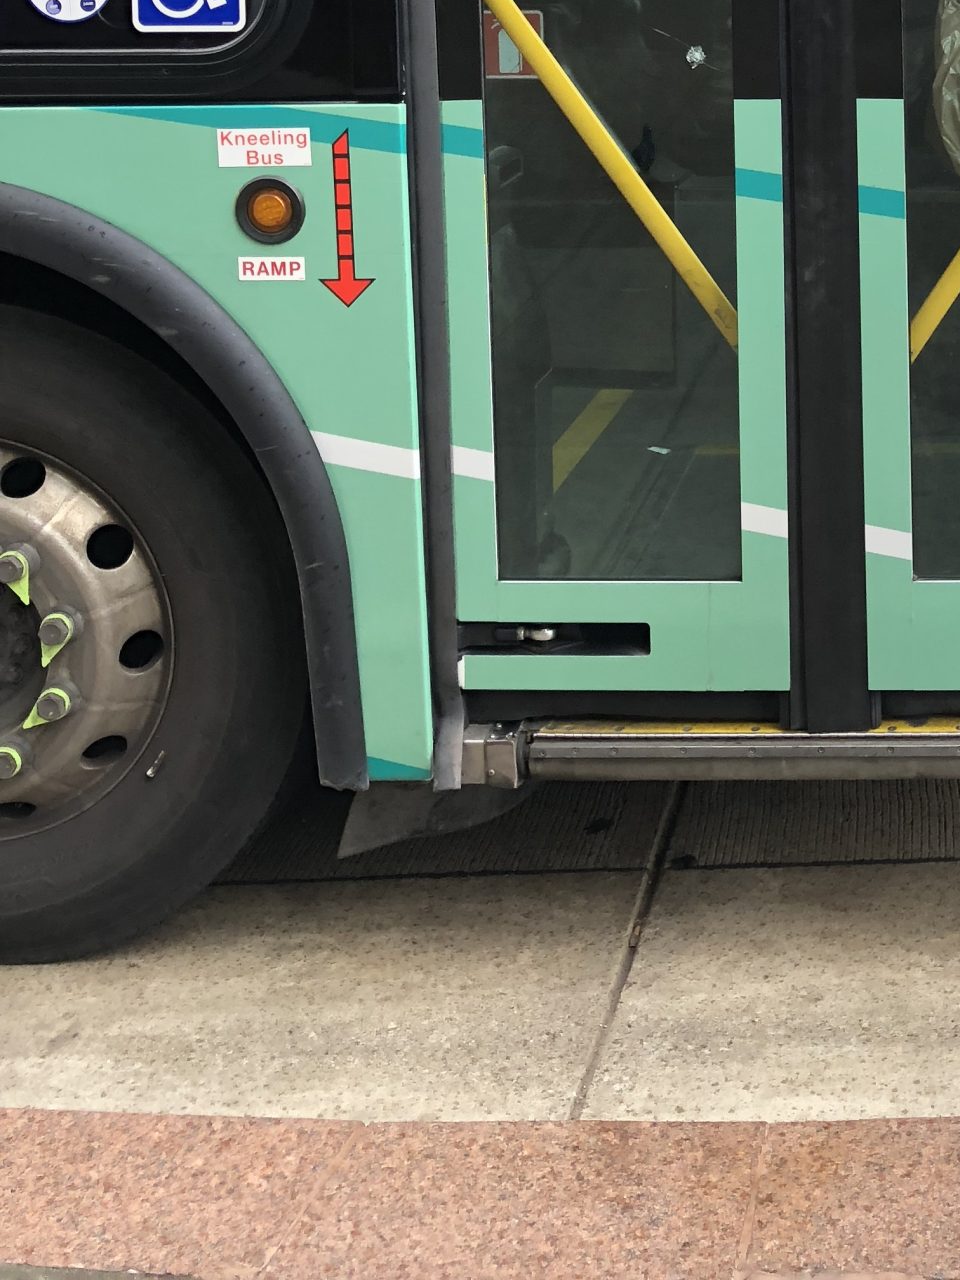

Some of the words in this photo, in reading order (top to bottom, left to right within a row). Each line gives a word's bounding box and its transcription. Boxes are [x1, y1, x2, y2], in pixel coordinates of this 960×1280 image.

[219, 130, 308, 149] Kneeling
[246, 151, 285, 166] Bus
[241, 261, 301, 276] RAMP
